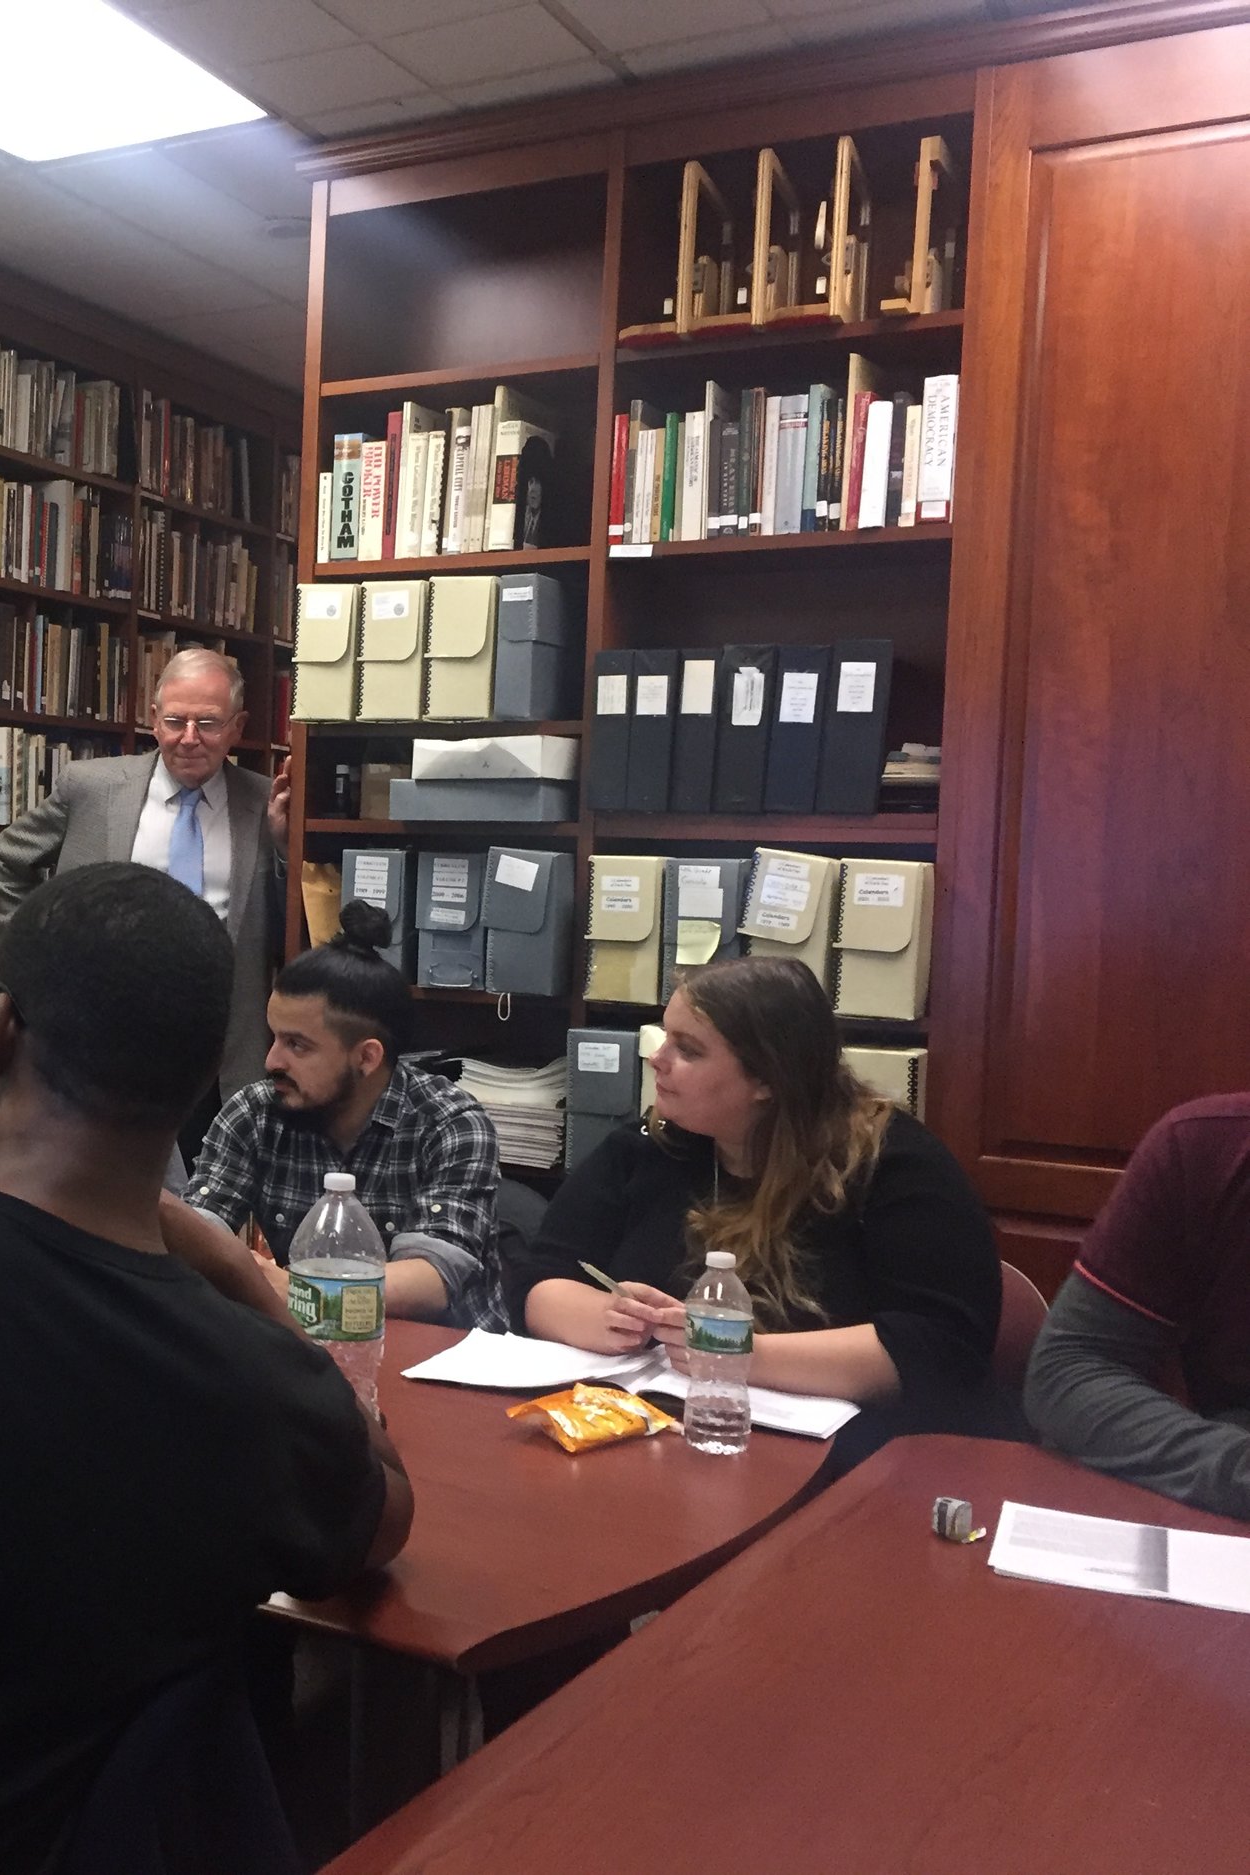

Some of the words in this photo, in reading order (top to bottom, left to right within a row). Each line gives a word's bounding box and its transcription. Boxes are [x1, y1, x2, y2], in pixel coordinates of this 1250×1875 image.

[925, 394, 937, 467] DEMOCRACY
[937, 393, 950, 467] AMERICAN
[362, 446, 374, 498] BROKER
[454, 448, 465, 476] CAPITAL
[502, 459, 510, 500] LEHMAN
[371, 475, 381, 518] POWER
[453, 476, 462, 492] CITY
[336, 471, 355, 549] GOTHAM
[761, 912, 790, 921] Calendars
